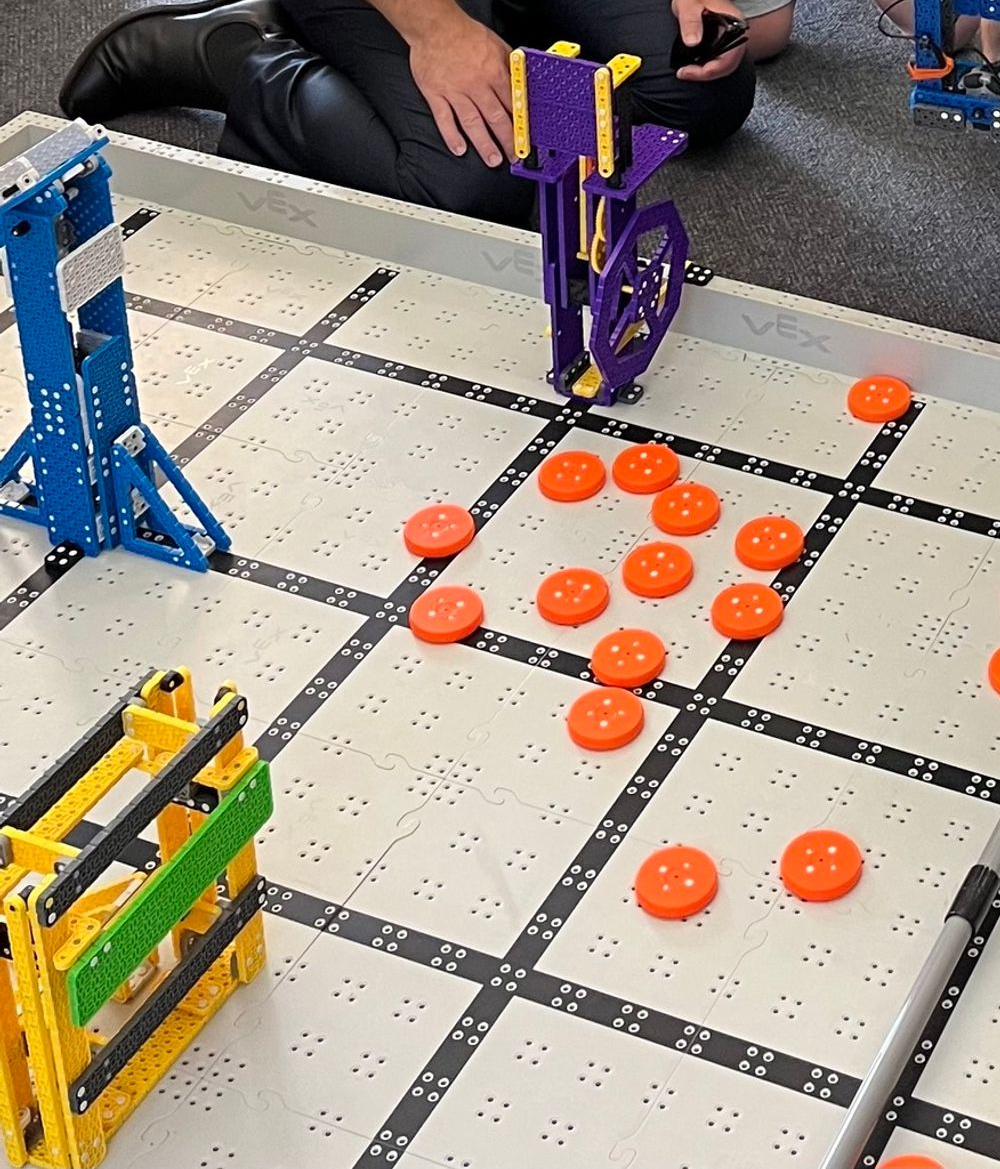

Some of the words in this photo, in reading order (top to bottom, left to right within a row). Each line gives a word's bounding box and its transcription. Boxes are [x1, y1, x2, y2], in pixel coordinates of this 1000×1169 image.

[236, 188, 318, 228] VEX
[481, 249, 541, 282] VE
[741, 312, 832, 354] VEX
